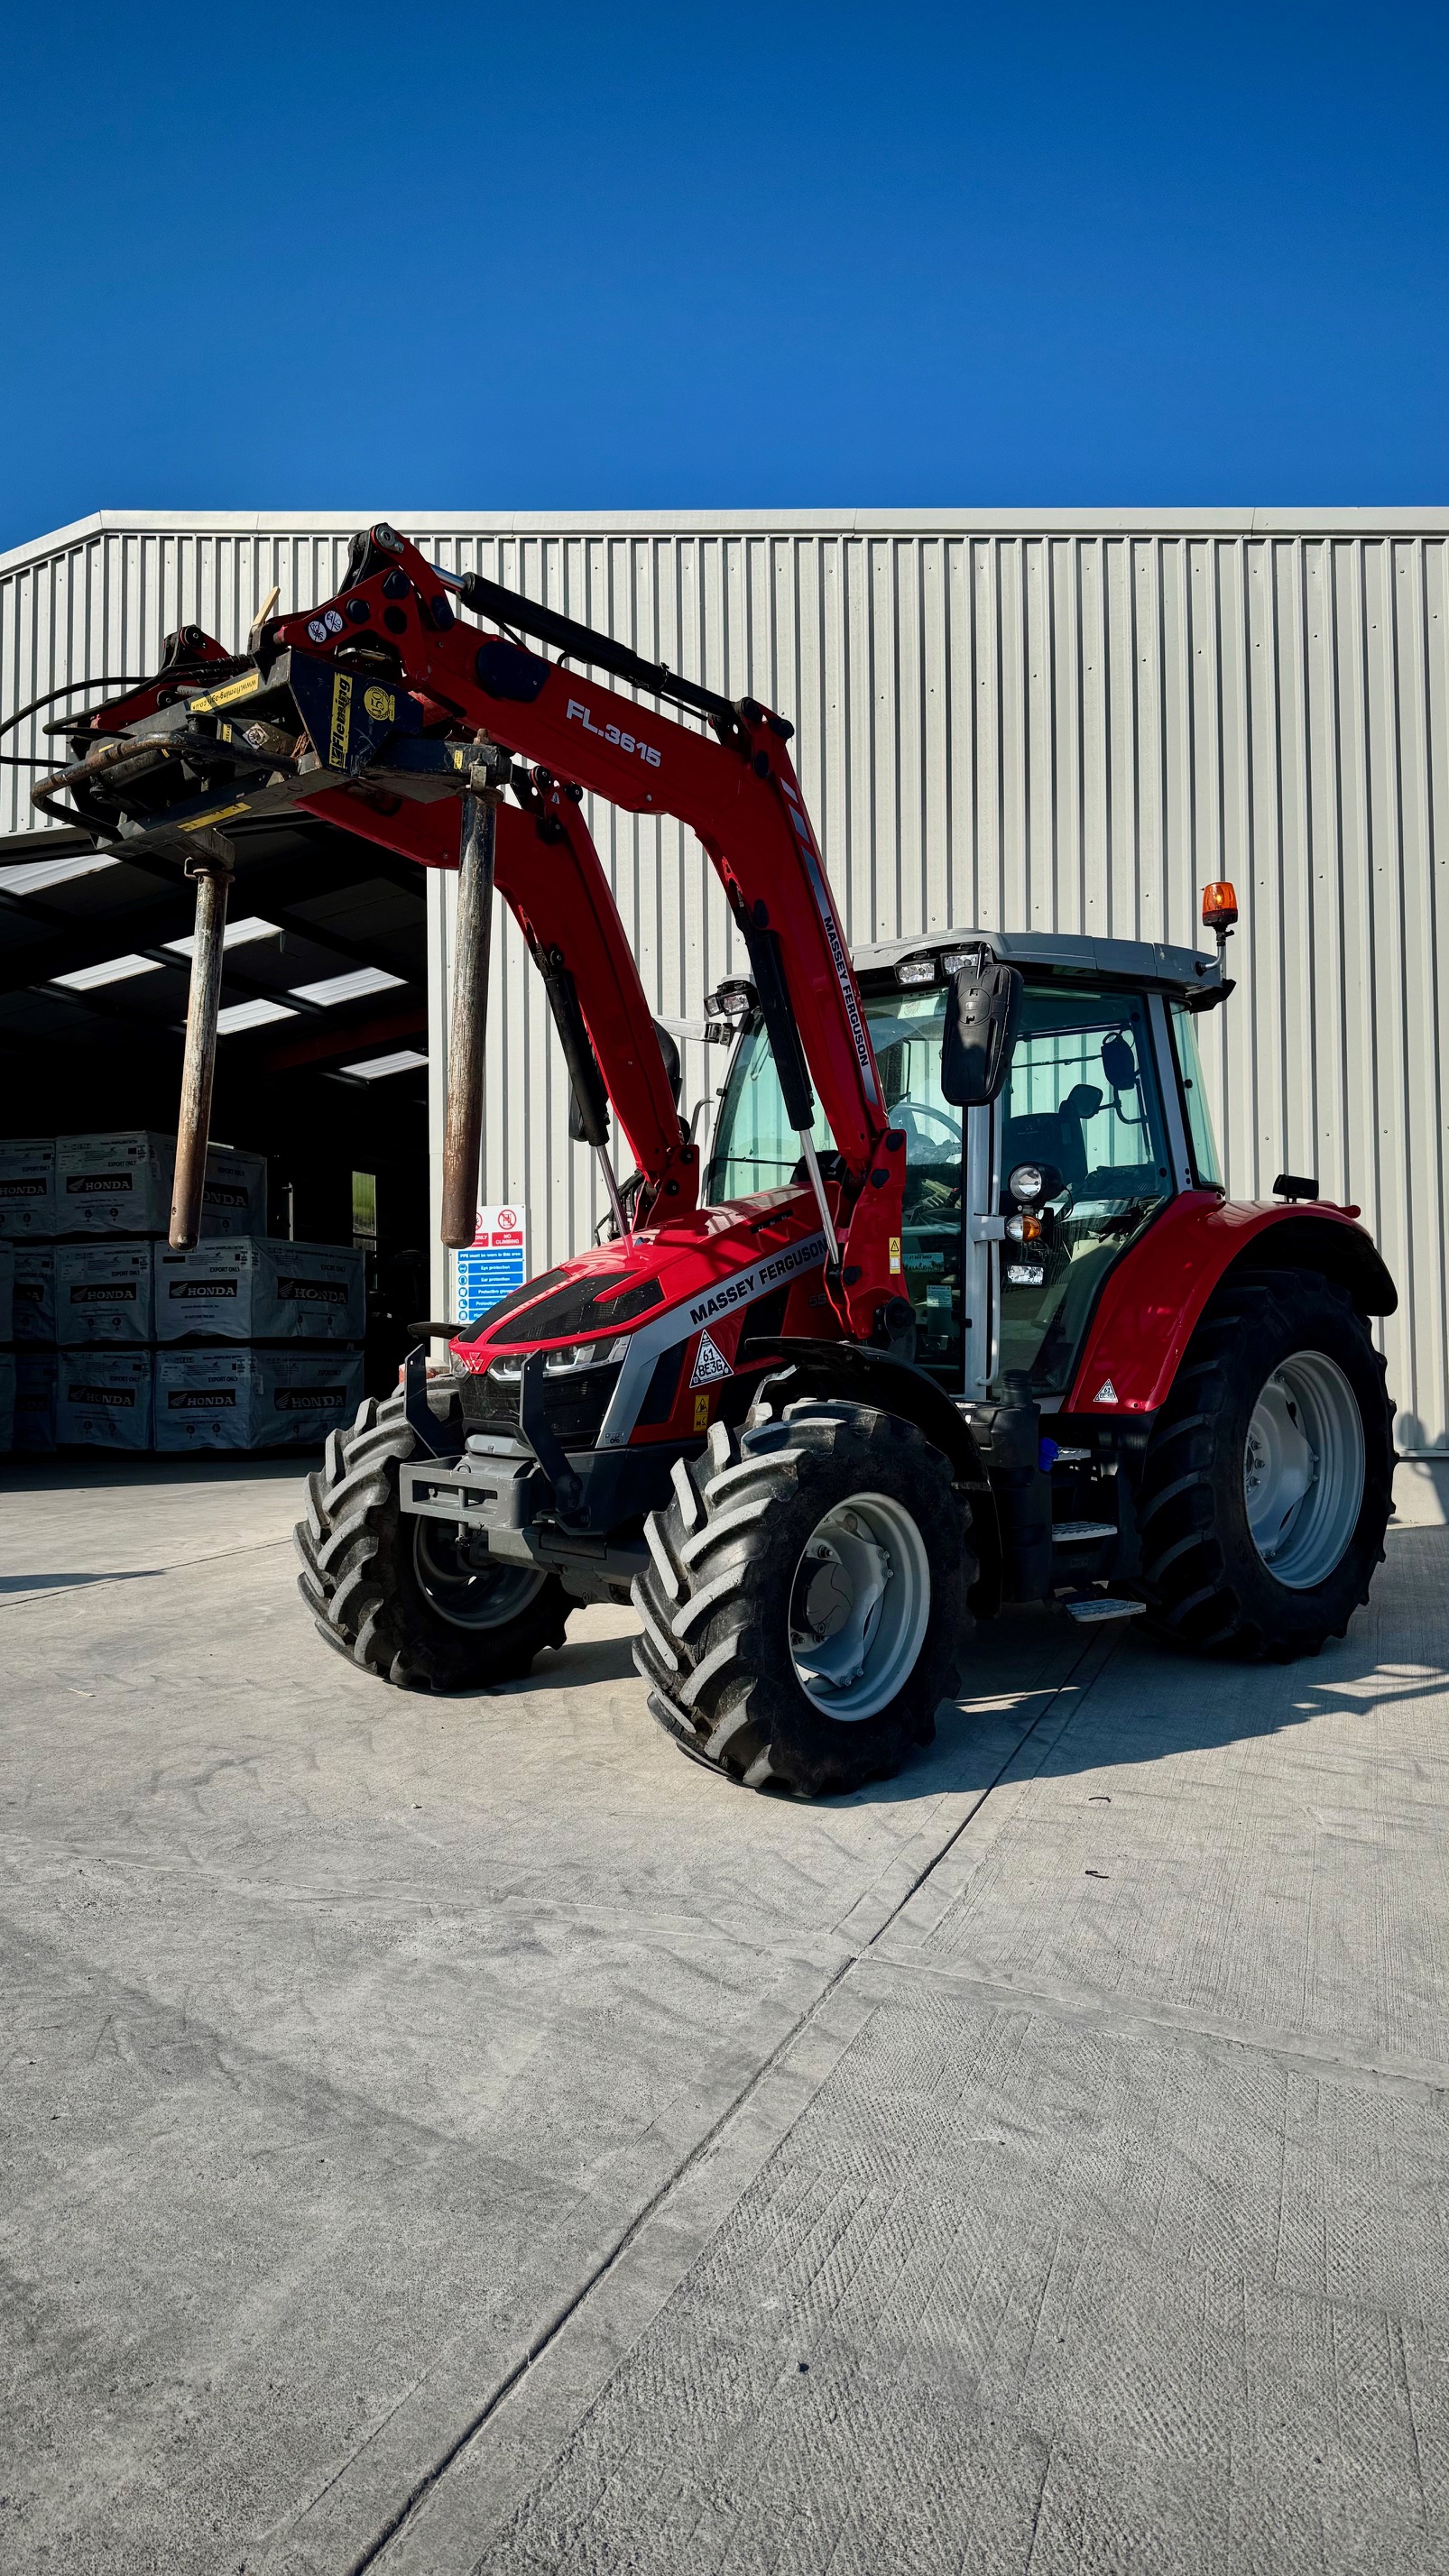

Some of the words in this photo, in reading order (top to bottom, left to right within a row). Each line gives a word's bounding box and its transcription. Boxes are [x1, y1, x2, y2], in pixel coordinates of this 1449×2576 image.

[371, 691, 384, 714] 150
[332, 677, 350, 751] Fleming
[567, 699, 661, 767] FL.3615
[823, 916, 848, 980] MASSEY
[842, 985, 869, 1067] FERGUSON
[0, 1186, 45, 1195] HONDA
[85, 1181, 131, 1191] HONDA
[203, 1191, 246, 1207] ONDA
[689, 1274, 755, 1325] MASSEY
[759, 1238, 827, 1284] FERGUSON
[88, 1291, 134, 1300] HONDA
[187, 1287, 235, 1296] HONDA
[293, 1287, 346, 1303] HONDA
[704, 1348, 715, 1362] 61
[698, 1359, 723, 1376] BE3G
[87, 1393, 133, 1405] HONDA
[186, 1396, 235, 1406] HONDA
[291, 1395, 345, 1408] HONDA
